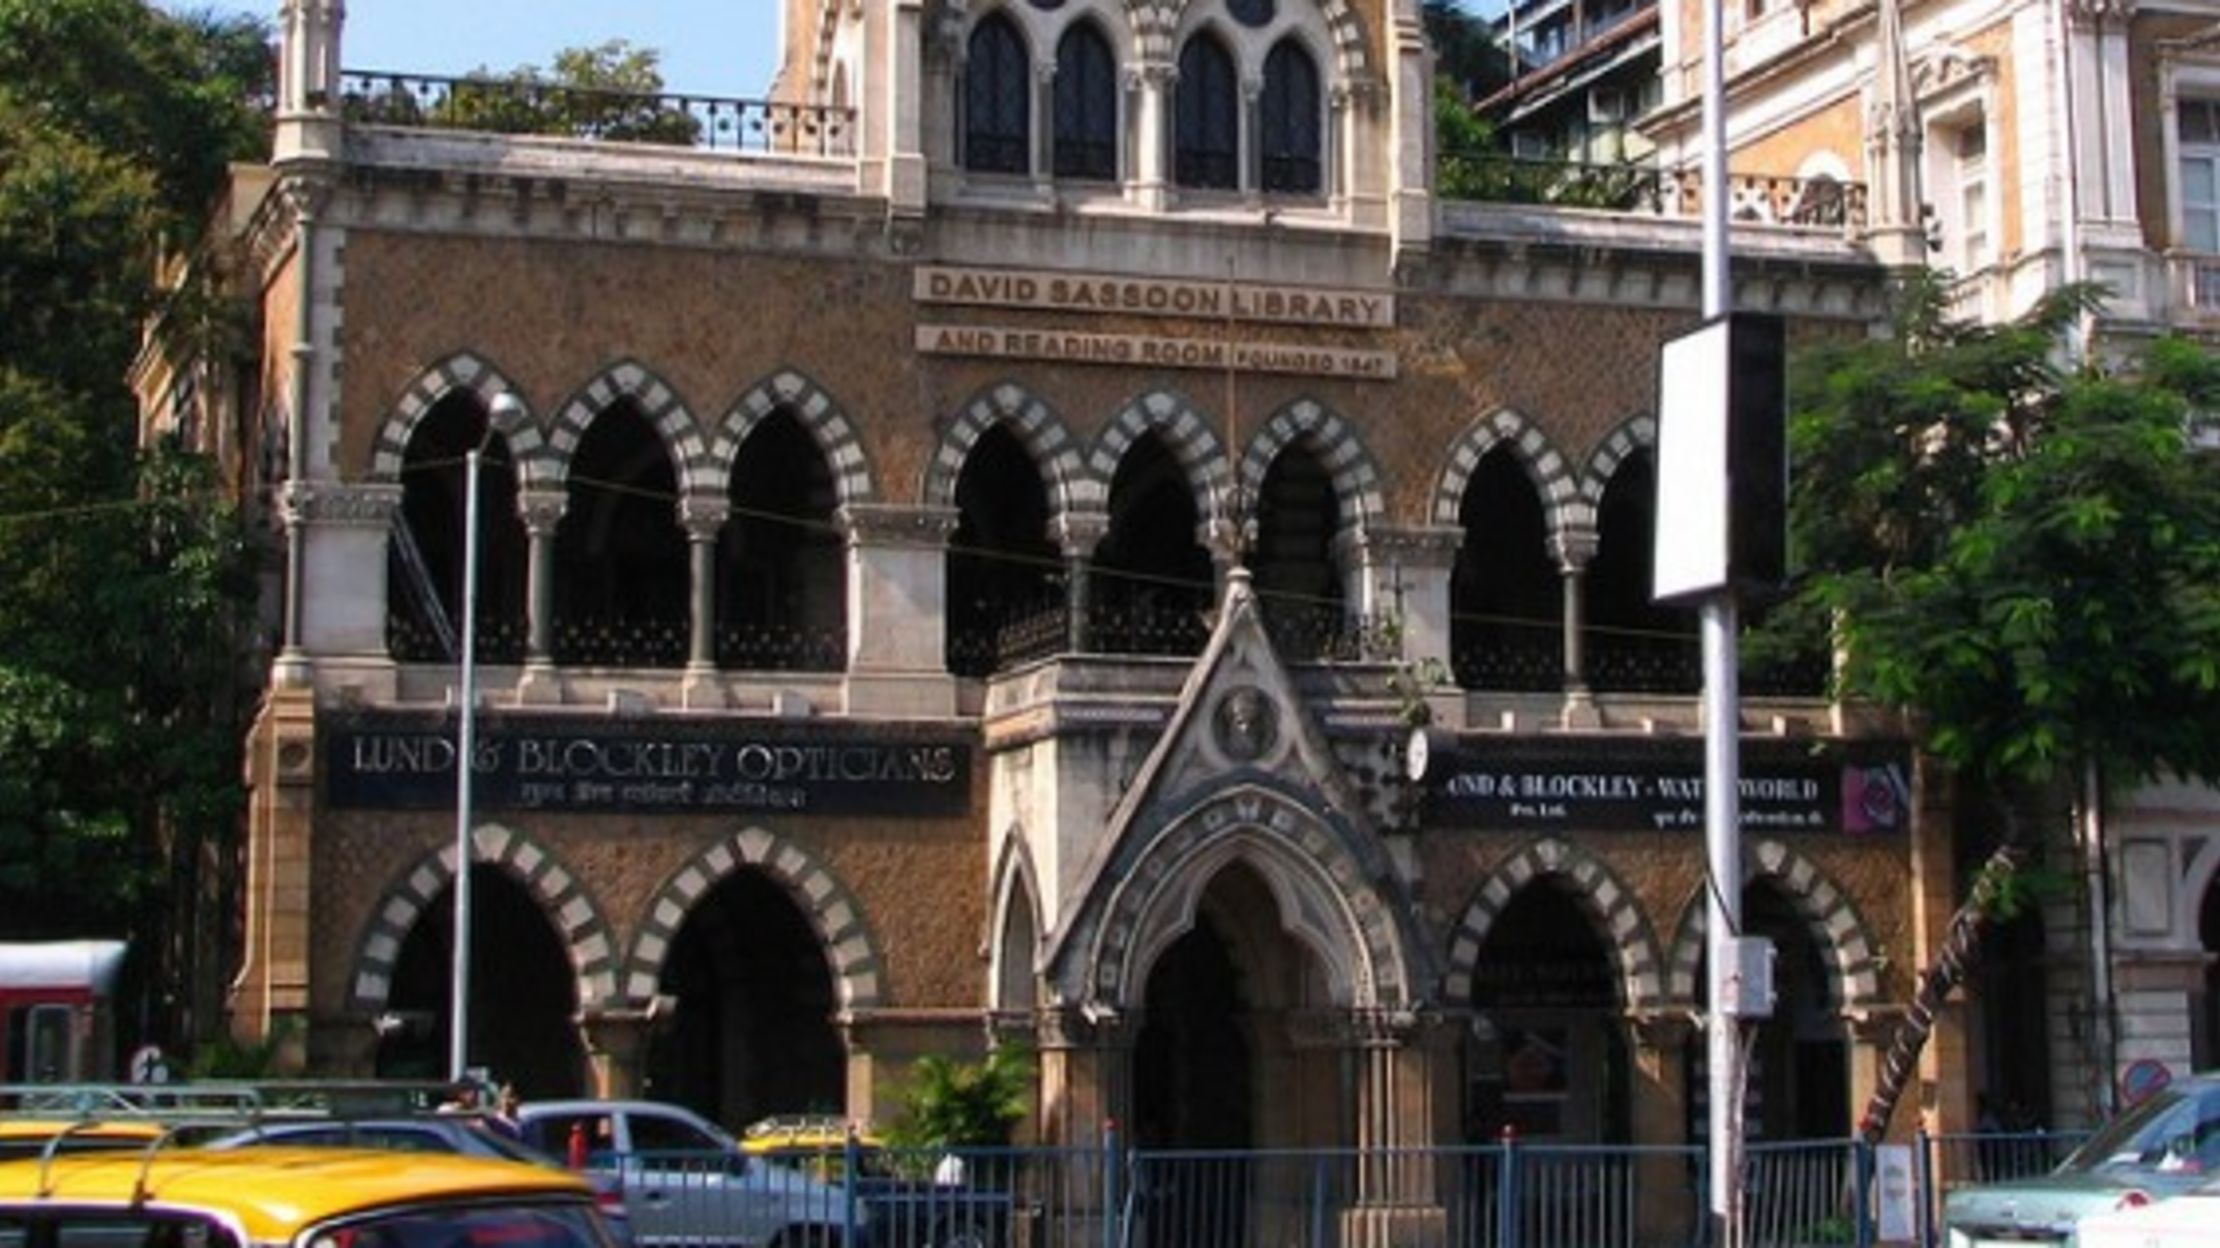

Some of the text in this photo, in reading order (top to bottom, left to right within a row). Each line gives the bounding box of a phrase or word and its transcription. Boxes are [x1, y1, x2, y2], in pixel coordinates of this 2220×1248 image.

[929, 274, 1379, 322] DAVID SASSOON LIBRARY
[936, 330, 995, 354] AND
[1004, 332, 1132, 359] READING
[1142, 341, 1224, 366] ROOM
[1237, 349, 1334, 372] FOUNDED
[352, 736, 455, 773] LUND
[517, 738, 726, 777] BLOCKLEY
[736, 743, 955, 782] OPTICIANS
[1448, 774, 1495, 796] UND
[1498, 775, 1515, 797] &
[1520, 775, 1641, 798] BLOCKLEY
